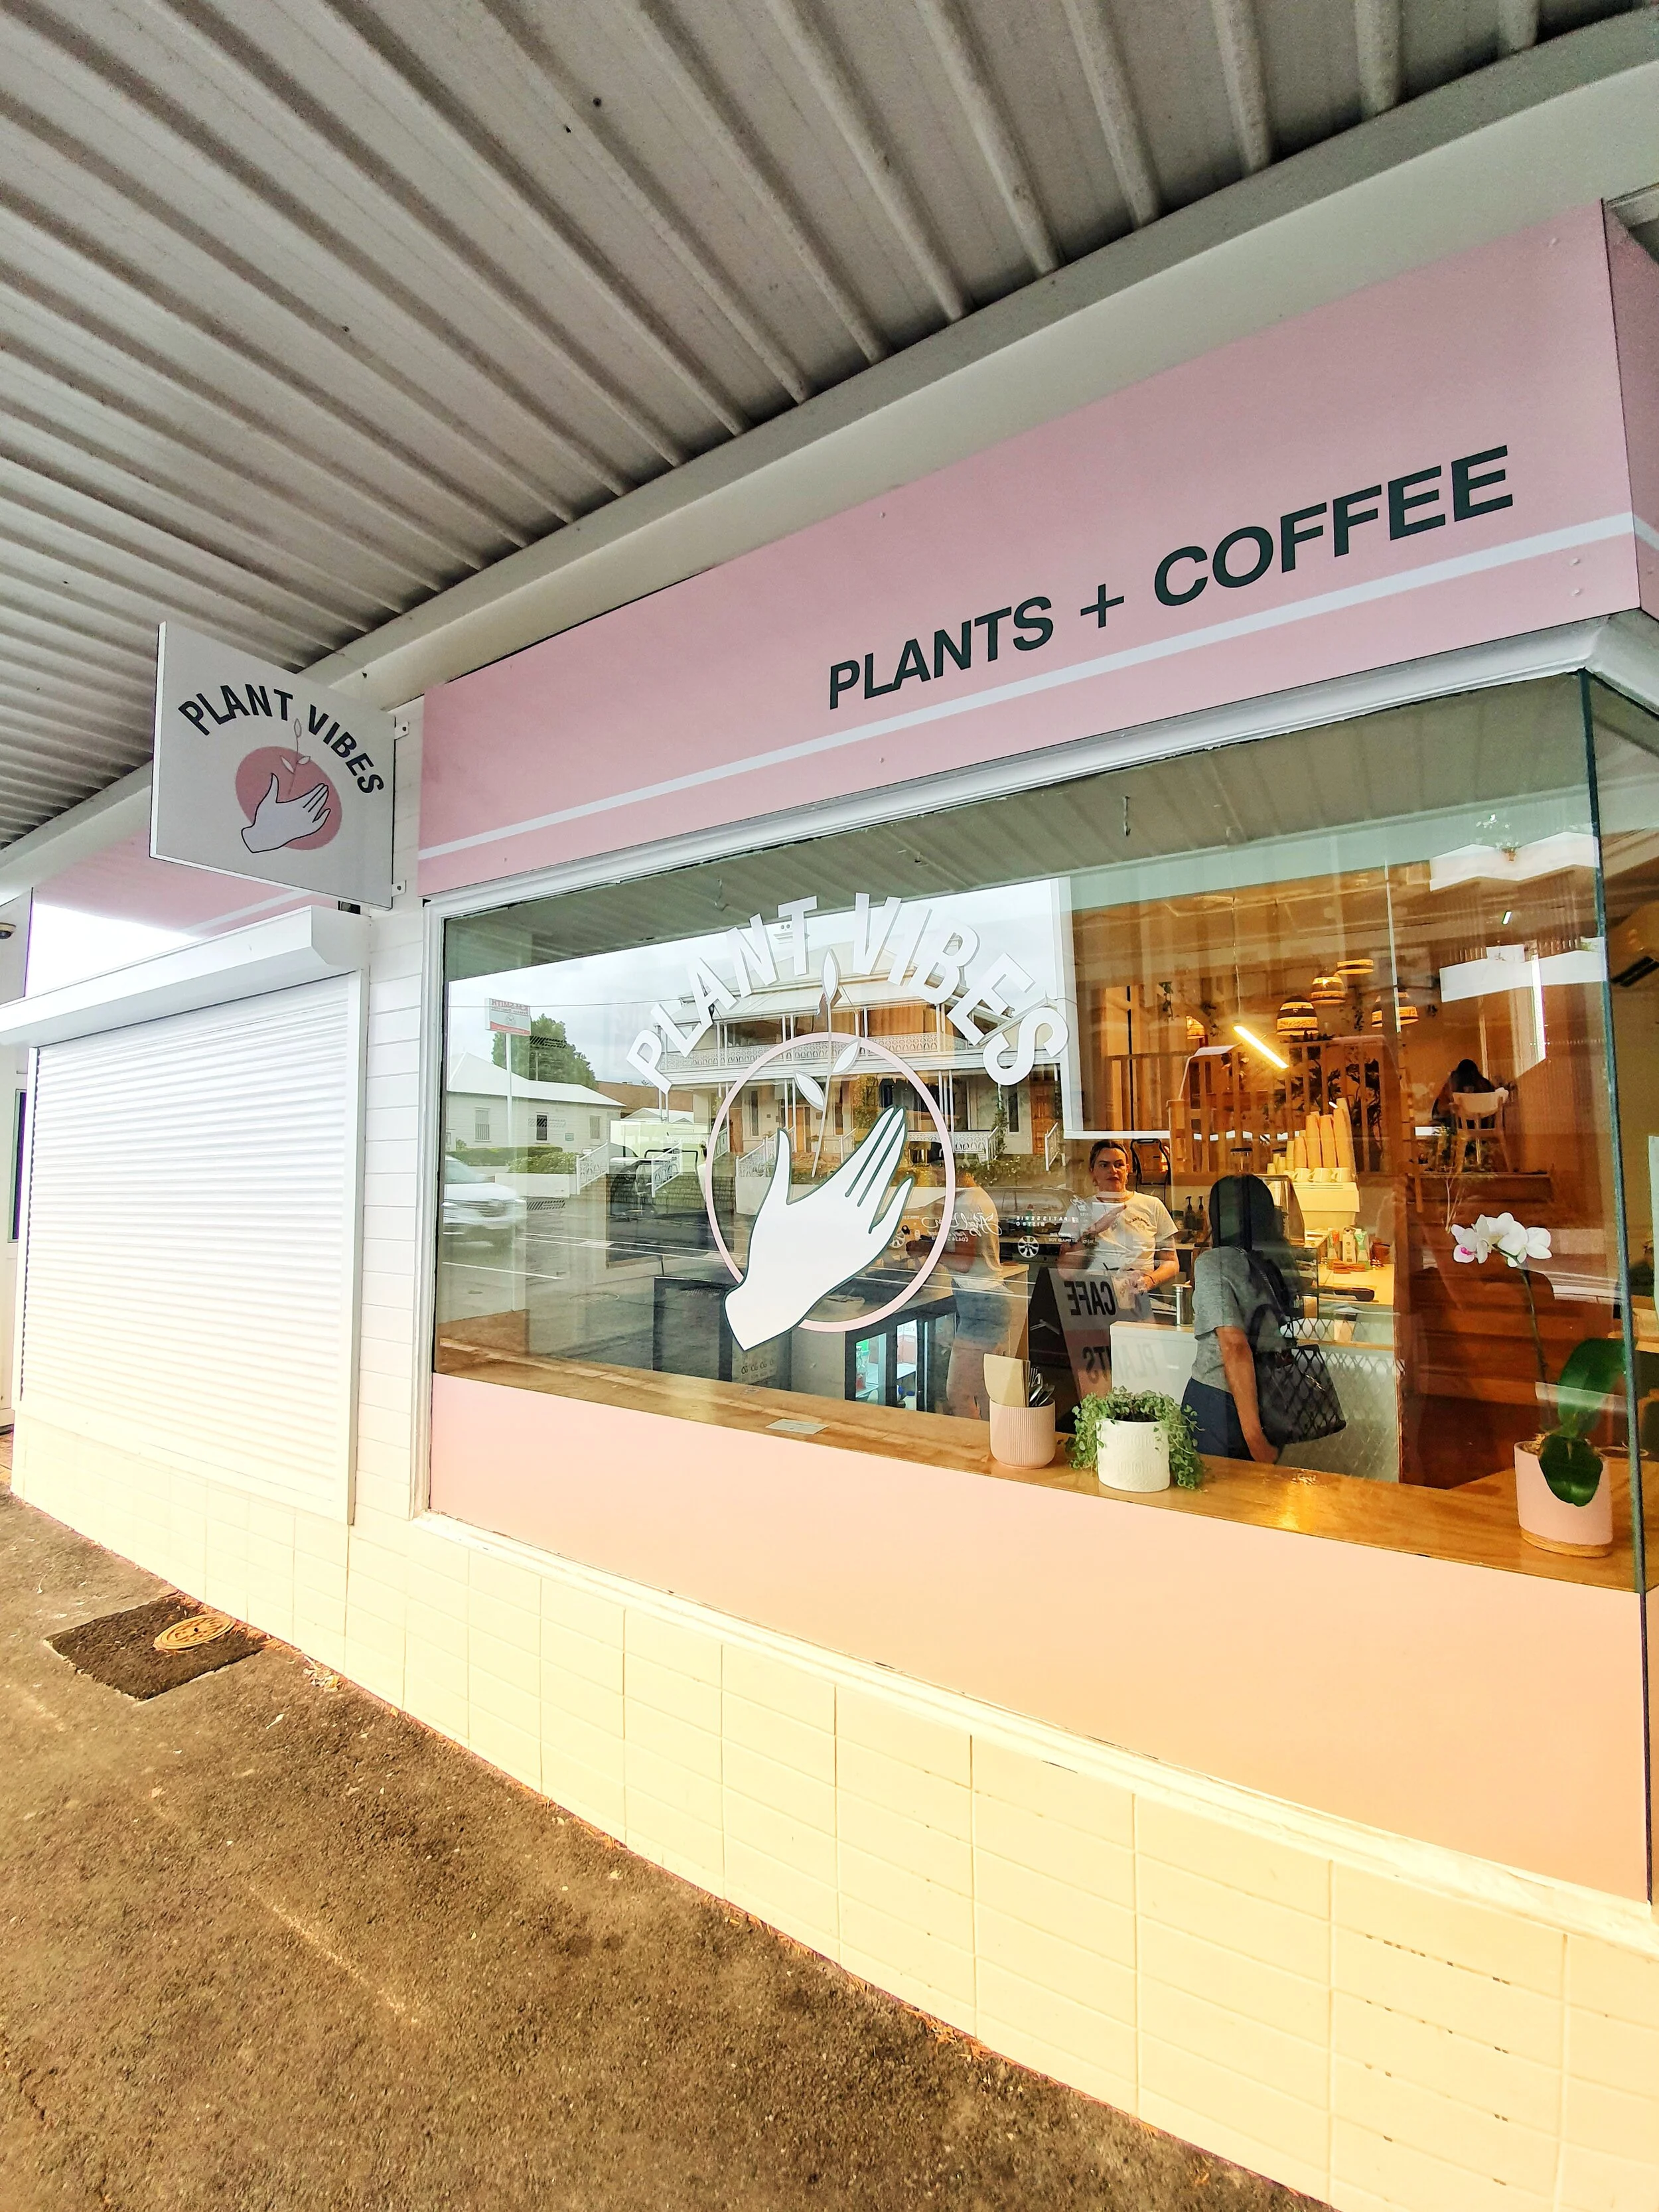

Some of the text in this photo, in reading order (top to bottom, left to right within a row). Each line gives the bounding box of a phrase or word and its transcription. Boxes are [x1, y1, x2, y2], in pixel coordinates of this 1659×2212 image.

[830, 595, 1054, 709] PLANTS
[1155, 445, 1514, 607] COFFEE
[178, 684, 385, 794] PLANT VIBES
[626, 893, 1069, 1093] PLANT VIBES
